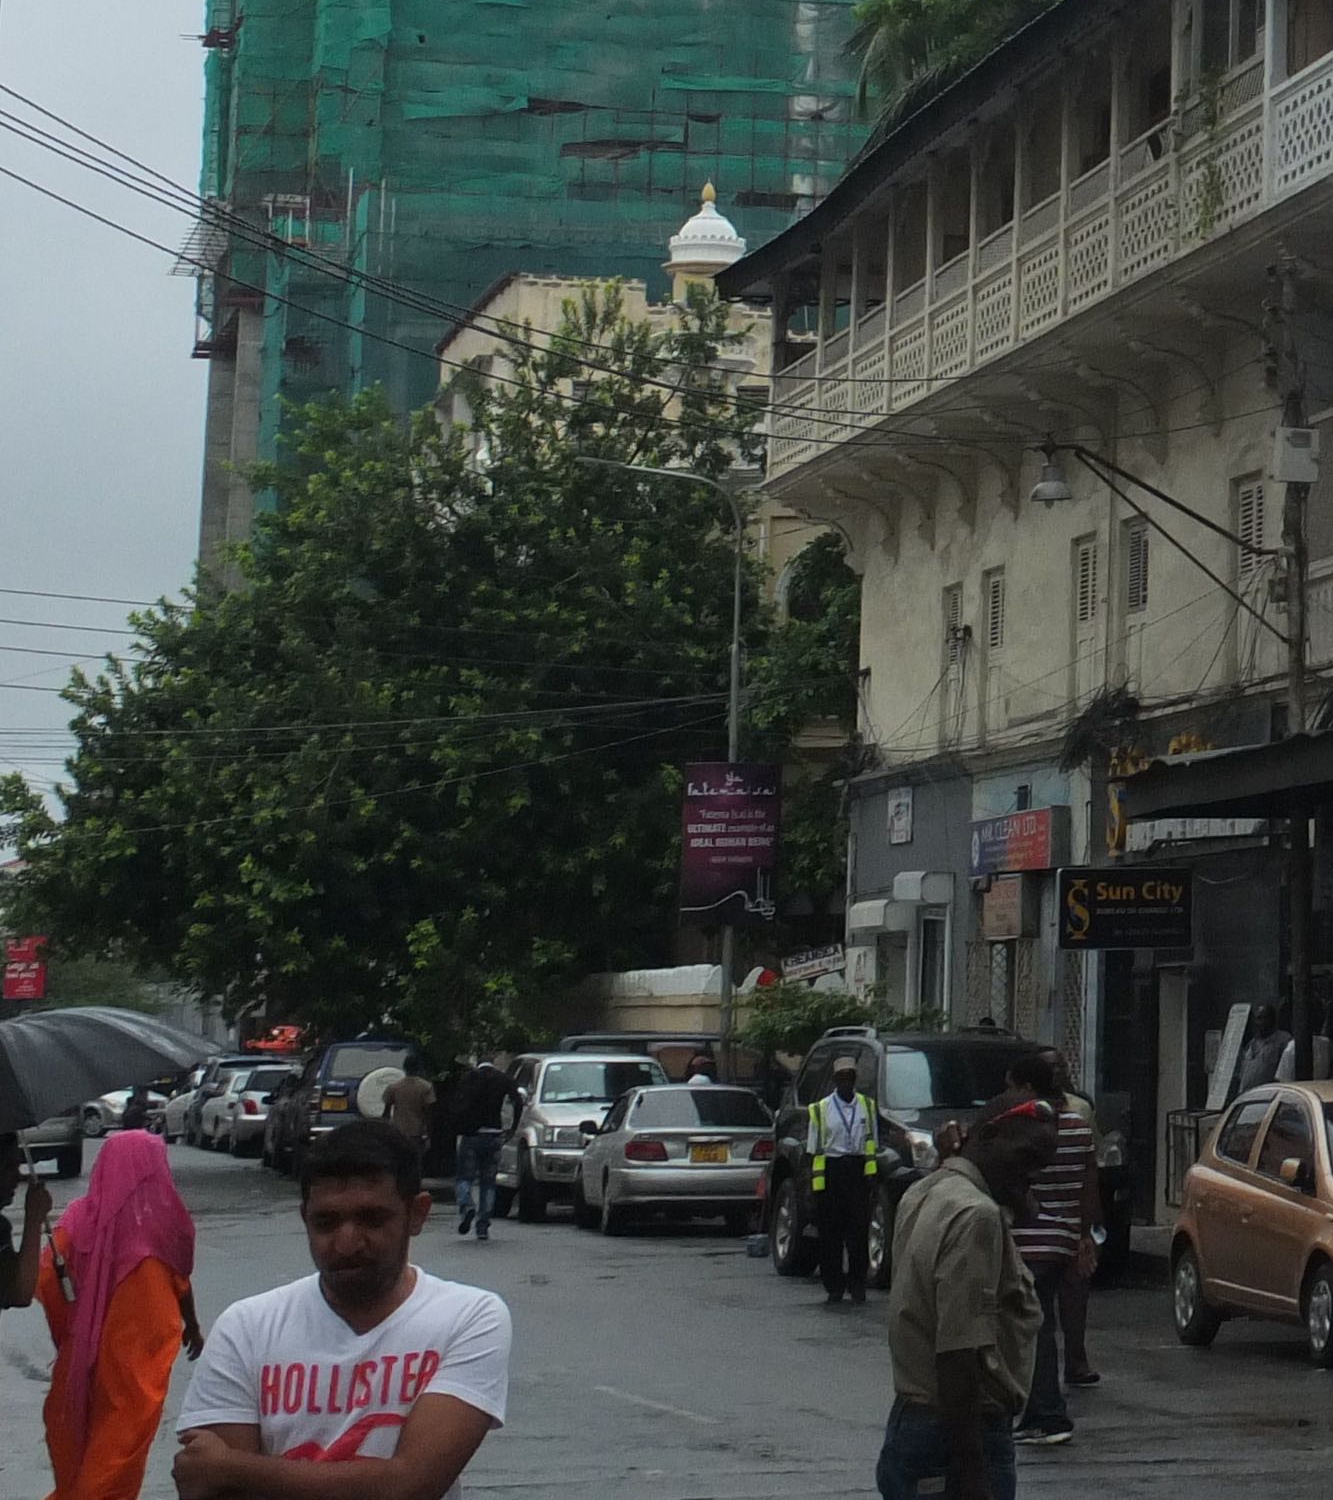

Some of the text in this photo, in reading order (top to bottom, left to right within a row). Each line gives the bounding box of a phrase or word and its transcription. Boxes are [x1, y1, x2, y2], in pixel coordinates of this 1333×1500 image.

[1096, 880, 1184, 904] Sun City
[260, 1350, 441, 1416] HOLLISTER
